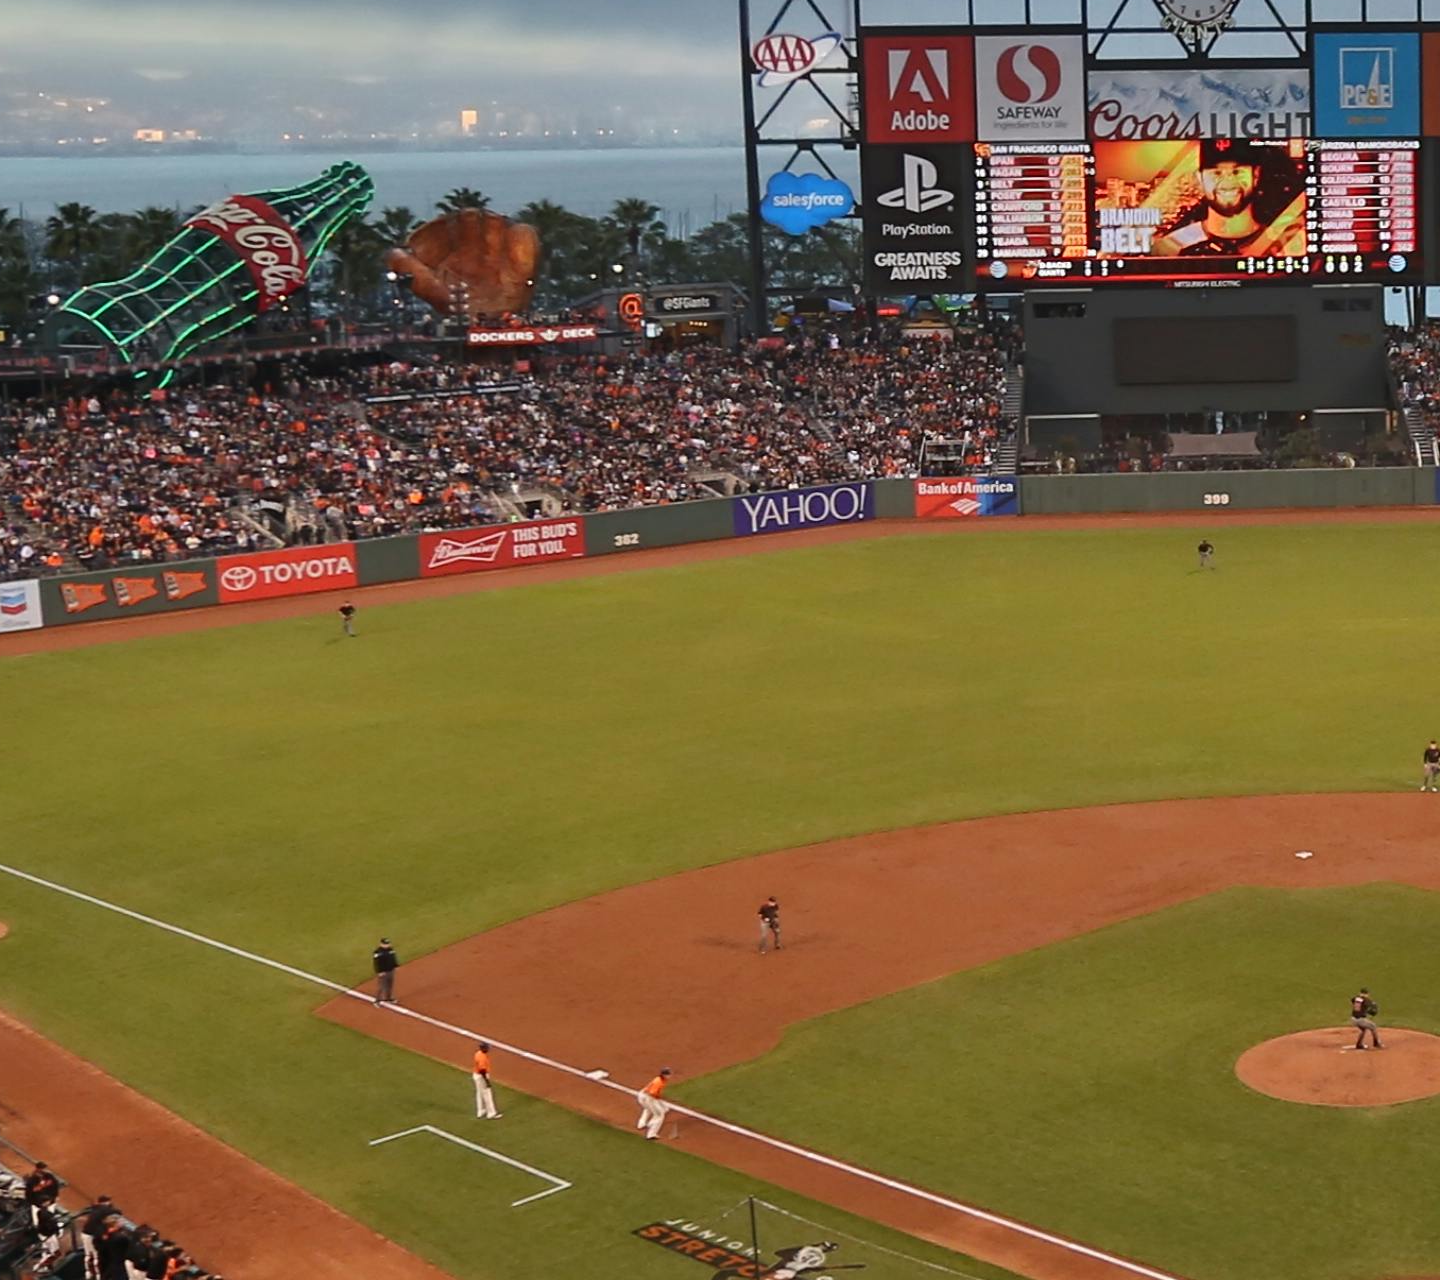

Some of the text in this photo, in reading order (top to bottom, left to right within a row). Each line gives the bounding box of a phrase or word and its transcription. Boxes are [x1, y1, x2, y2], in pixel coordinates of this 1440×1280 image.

[761, 36, 812, 72] AAA
[1343, 83, 1392, 107] PG&E
[891, 110, 950, 131] Adobe
[997, 106, 1062, 119] SAFEWAY
[1088, 99, 1310, 140] Coors LIGHT
[773, 193, 844, 209] salesforce
[1100, 208, 1160, 225] BRANDON
[882, 224, 951, 238] PlayStation
[1100, 226, 1154, 253] BELT
[875, 252, 961, 268] GREATNESS
[663, 297, 710, 311] @SFGiants
[470, 328, 595, 343] DOCKERS DECK
[918, 480, 1014, 495] Bank of America
[1204, 493, 1230, 505] 399
[741, 484, 868, 533] YAHOO!
[512, 522, 579, 542] THIS BUD'S
[614, 533, 639, 547] 382
[513, 540, 567, 558] FOR YOU.
[260, 557, 353, 584] TOYOTA
